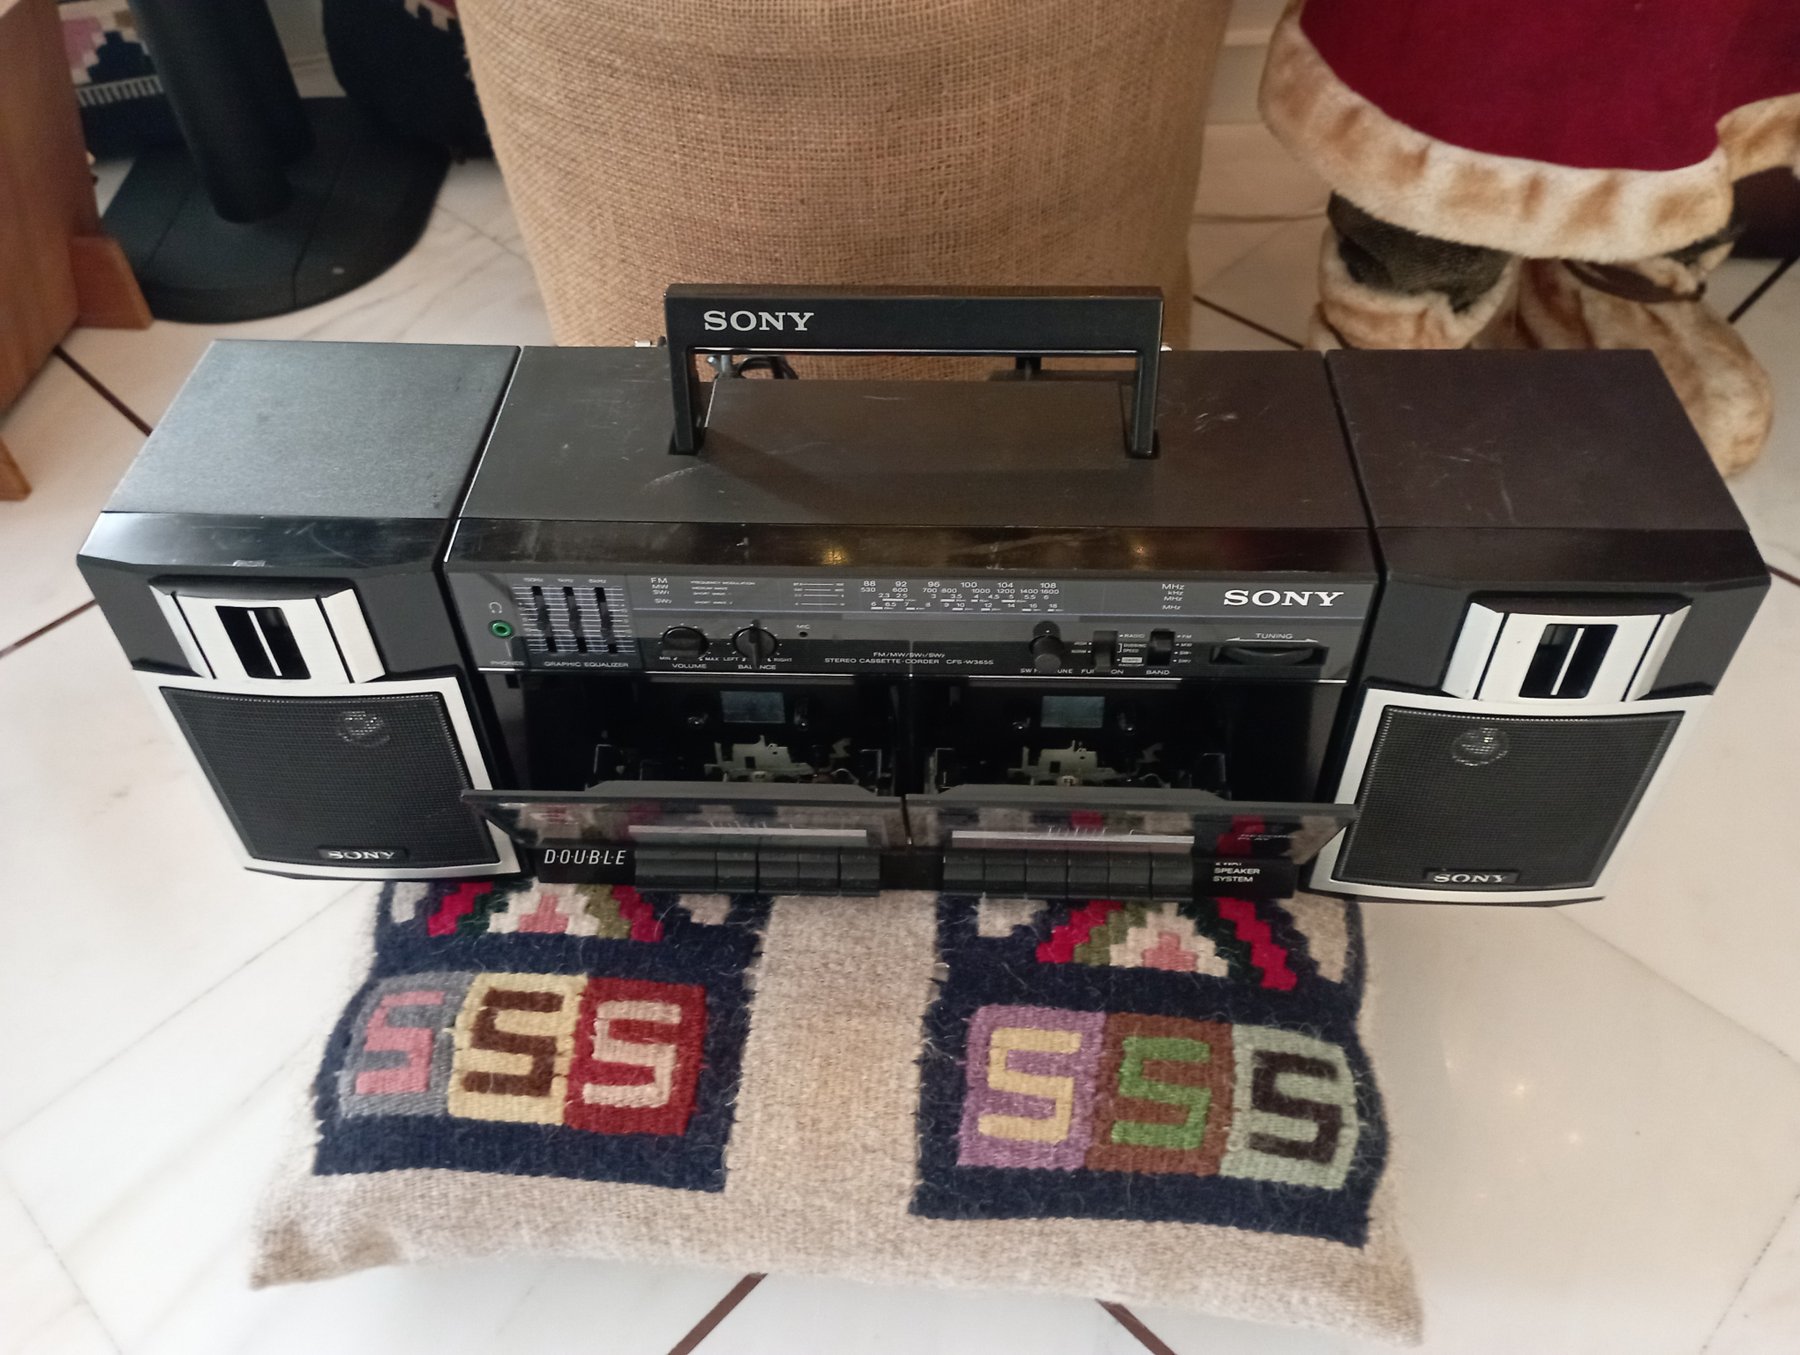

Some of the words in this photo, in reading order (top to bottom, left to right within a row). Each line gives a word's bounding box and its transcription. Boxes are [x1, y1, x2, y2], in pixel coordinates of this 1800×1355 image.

[702, 310, 815, 331] SONY
[1223, 589, 1345, 607] SONY
[327, 850, 395, 860] SONY
[1214, 867, 1261, 875] SPEAKER
[1213, 875, 1254, 883] SYSTEM
[1433, 873, 1507, 883] SONY
